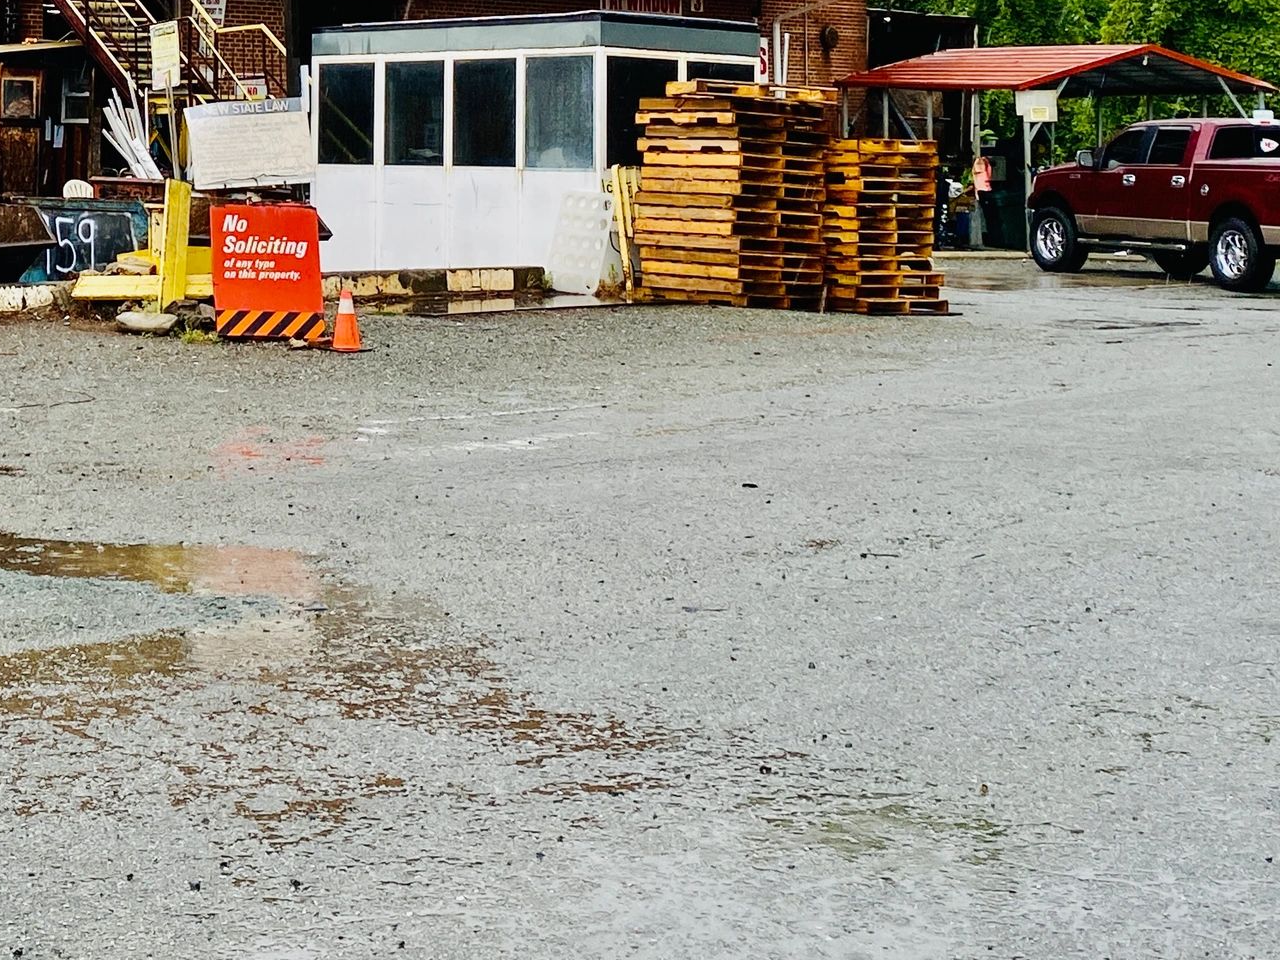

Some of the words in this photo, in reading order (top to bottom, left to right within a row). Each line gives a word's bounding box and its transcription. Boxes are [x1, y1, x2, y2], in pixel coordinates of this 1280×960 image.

[232, 102, 263, 113] STATE
[265, 100, 289, 112] LAW
[222, 214, 248, 232] No
[222, 235, 308, 258] Soliciting
[223, 257, 236, 268] of
[235, 260, 253, 270] any
[255, 259, 276, 270] type
[223, 270, 236, 279] on
[238, 269, 257, 279] this
[258, 270, 301, 281] property.
